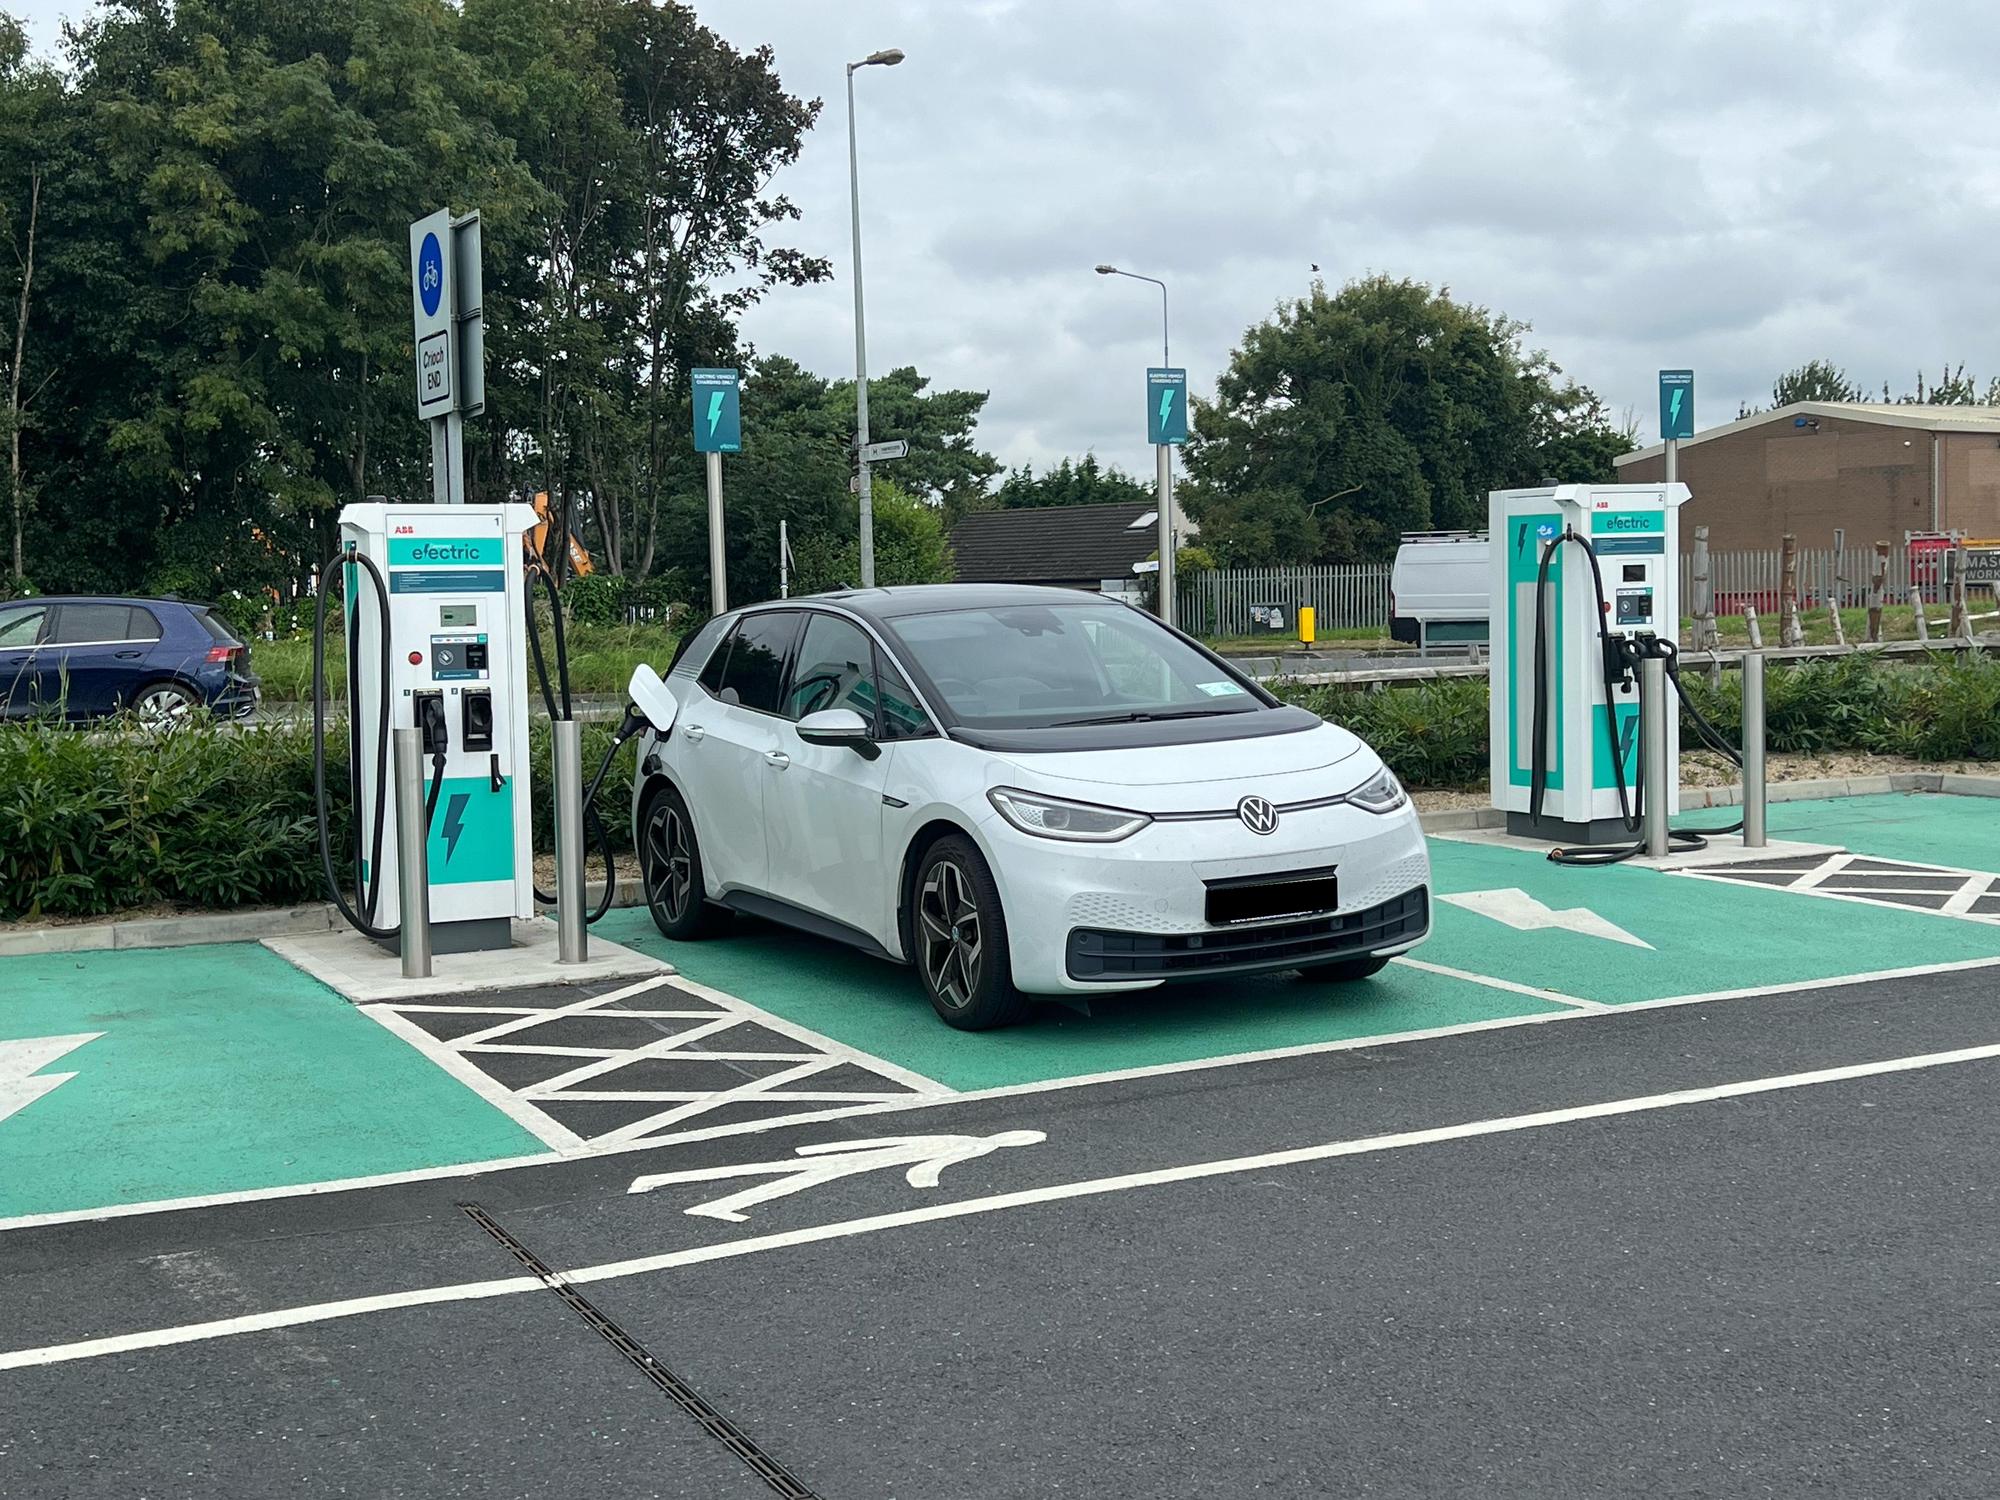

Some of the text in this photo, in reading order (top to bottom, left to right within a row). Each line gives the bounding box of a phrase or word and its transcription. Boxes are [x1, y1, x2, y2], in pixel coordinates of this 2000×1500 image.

[427, 370, 442, 390] END
[1658, 494, 1664, 502] 2
[493, 517, 500, 526] 1
[395, 526, 414, 534] ABB
[1966, 556, 2000, 569] MAS
